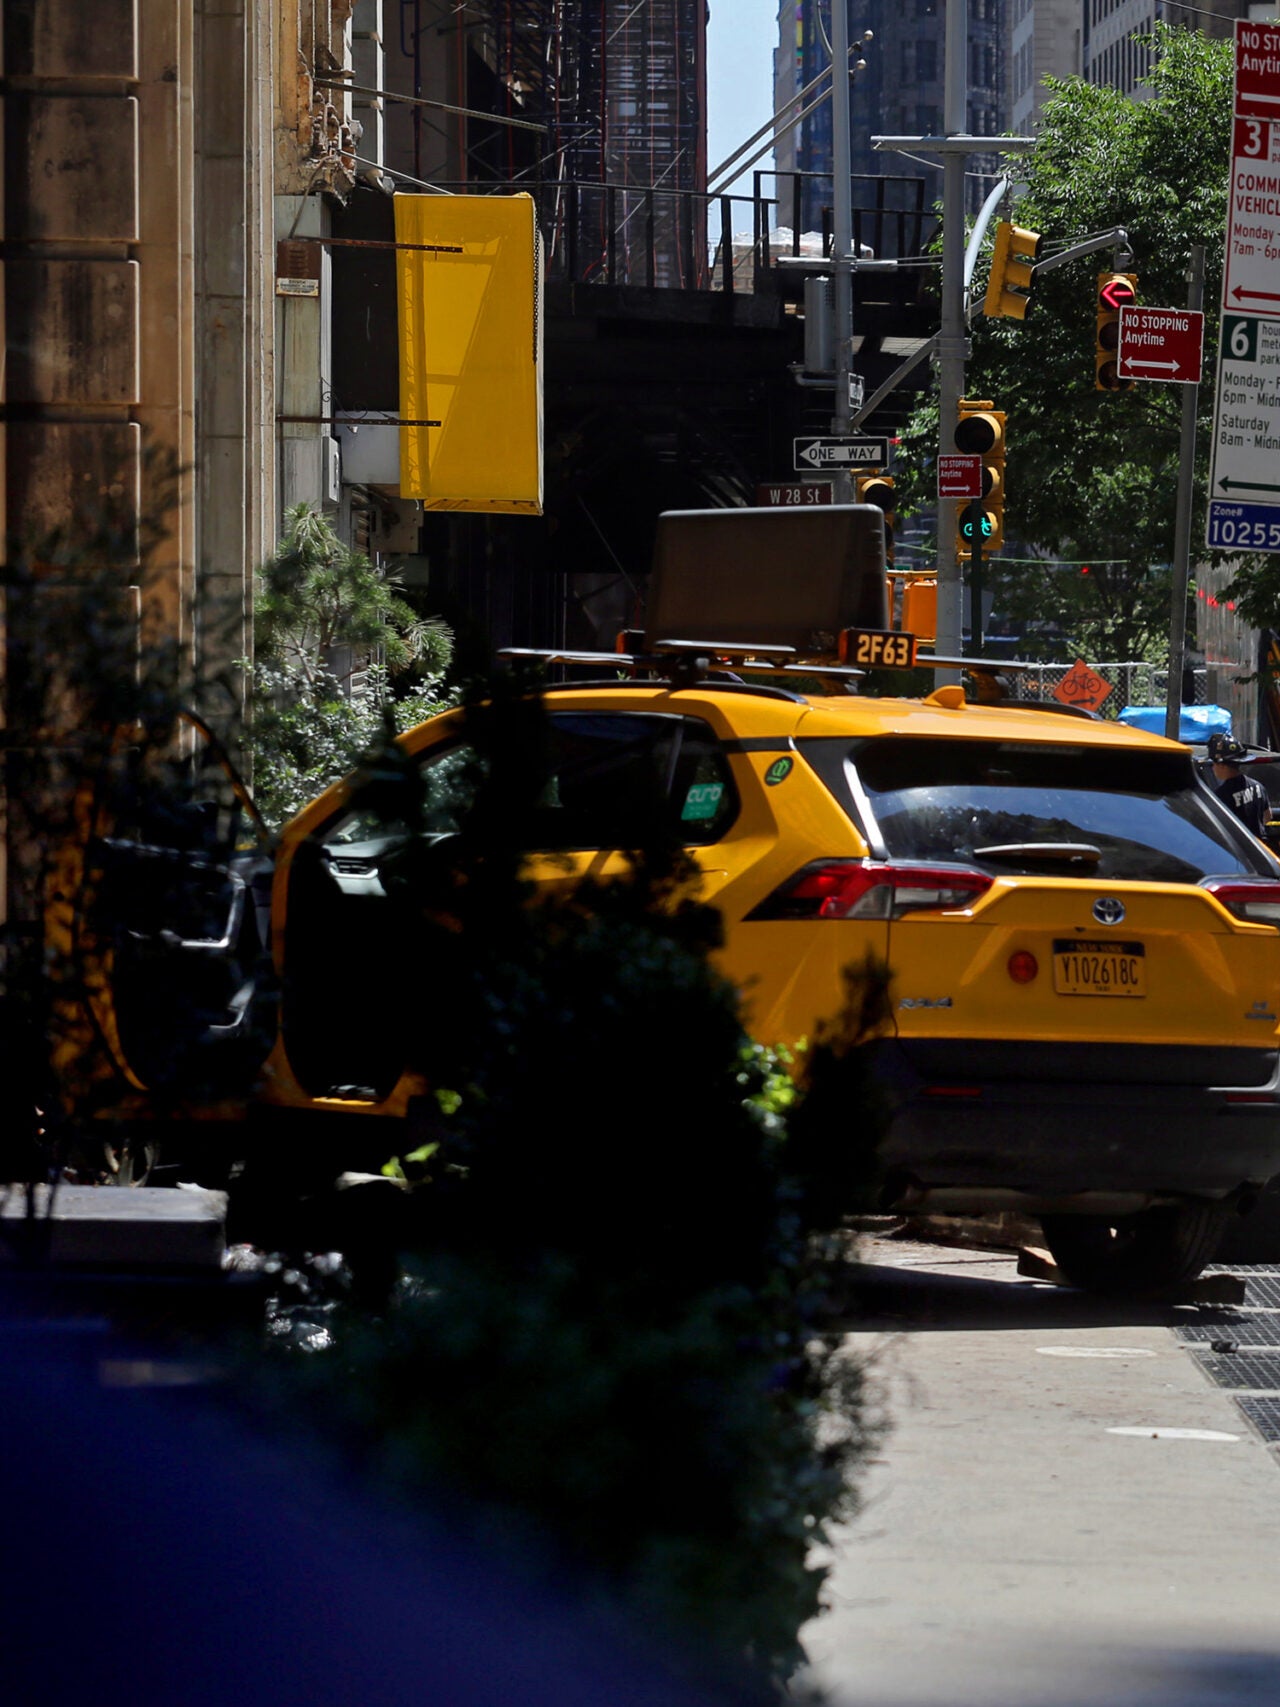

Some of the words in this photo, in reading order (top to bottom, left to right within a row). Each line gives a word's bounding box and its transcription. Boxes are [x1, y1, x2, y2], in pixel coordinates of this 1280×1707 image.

[1241, 31, 1260, 49] NO
[1243, 120, 1262, 155] 3
[1233, 222, 1275, 243] Monday
[1233, 240, 1254, 256] 7am
[1125, 314, 1139, 328] NO
[1141, 315, 1189, 332] STOPPING
[1124, 330, 1165, 347] Anytime
[1230, 321, 1250, 357] 6
[1224, 371, 1266, 391] Monday
[1223, 389, 1247, 405] 6pm
[1221, 413, 1270, 434] Saturday
[1220, 431, 1244, 447] 8am
[809, 448, 836, 461] ONE
[847, 447, 876, 460] WAY
[940, 460, 949, 468] NO
[949, 460, 975, 468] STOPPING
[940, 470, 962, 479] Anytime
[769, 488, 781, 504] W
[785, 488, 801, 504] 28
[807, 487, 820, 504] St
[1213, 505, 1244, 517] Zone#
[857, 634, 909, 667] 2F63
[686, 786, 722, 803] curb
[1062, 956, 1139, 985] Y102618C
